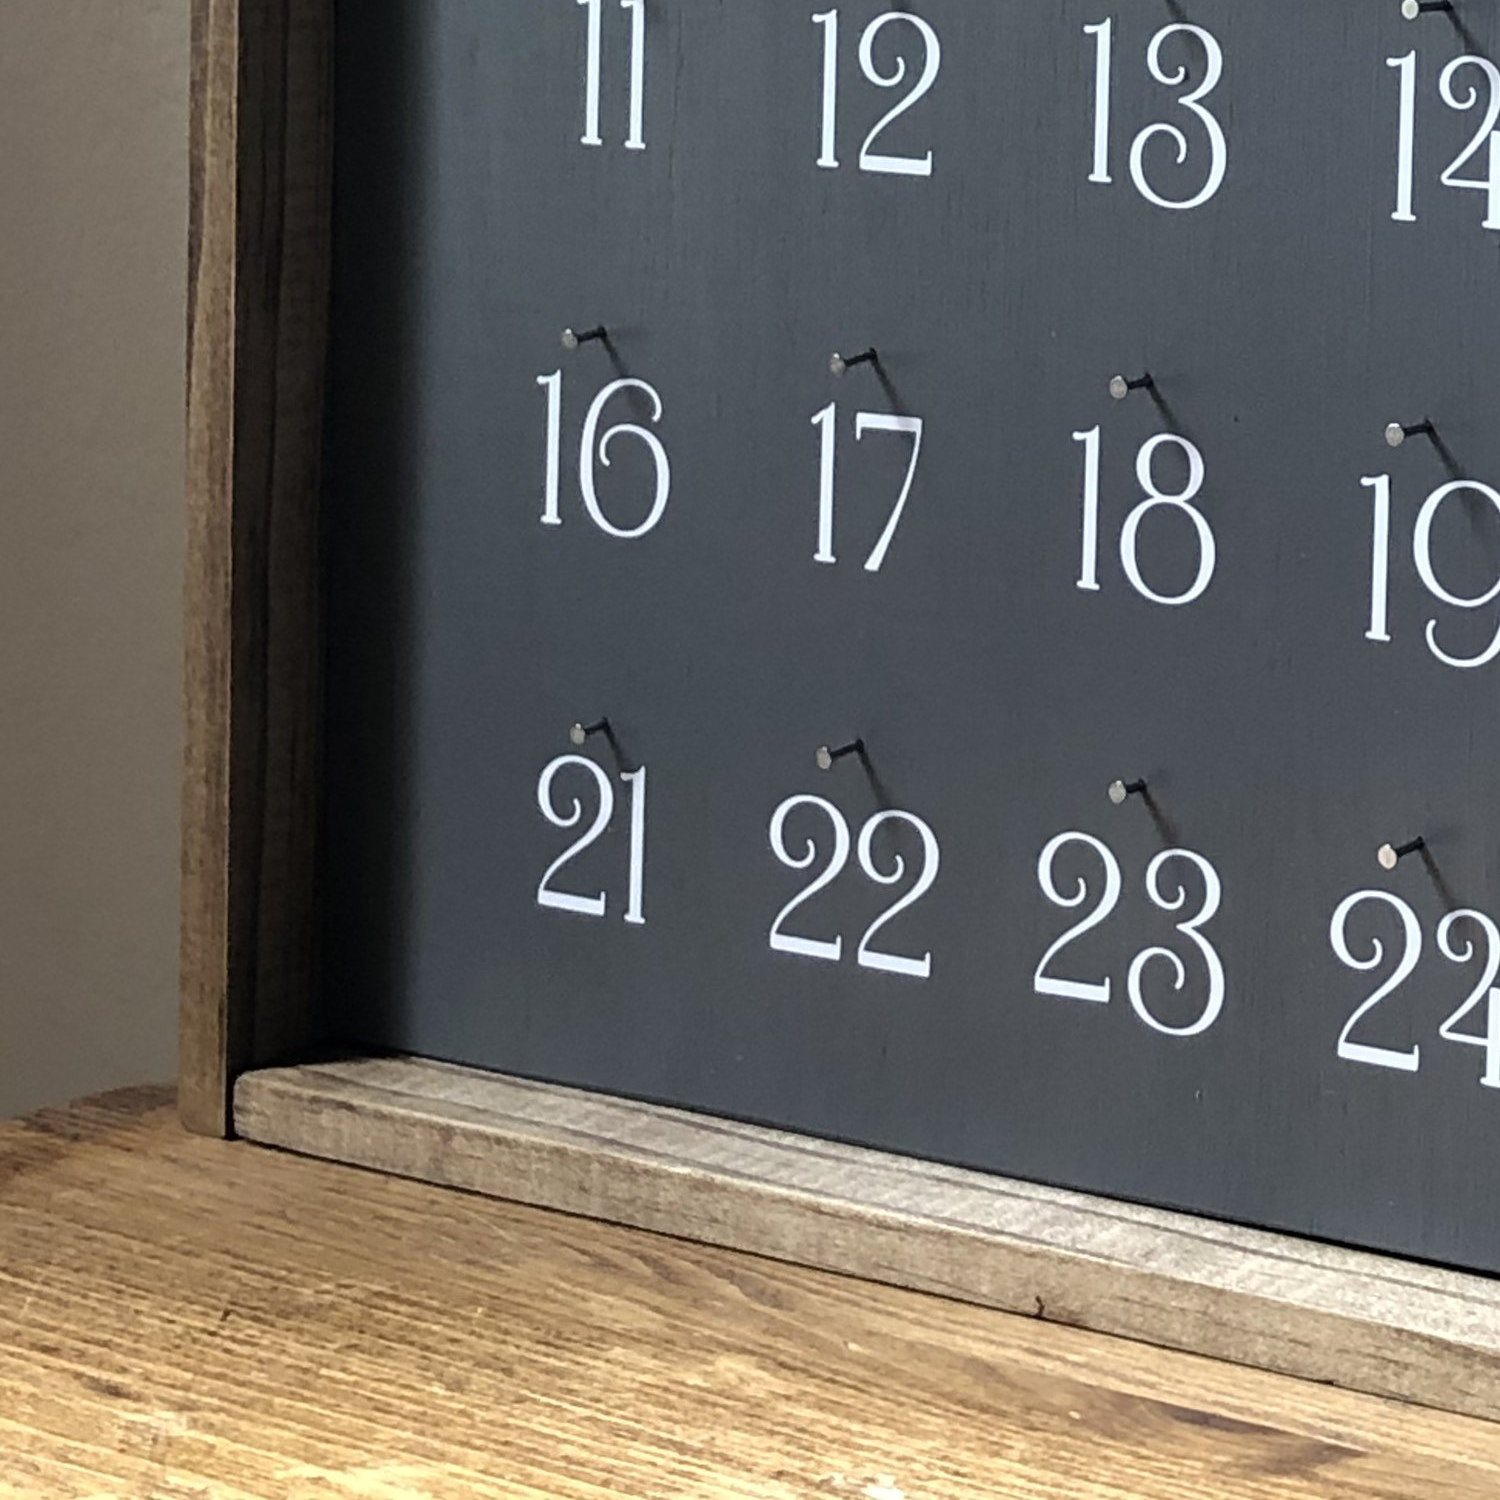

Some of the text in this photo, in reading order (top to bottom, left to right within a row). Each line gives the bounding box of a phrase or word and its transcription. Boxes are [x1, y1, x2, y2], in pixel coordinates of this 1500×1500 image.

[811, 8, 941, 177] 12
[1082, 16, 1227, 210] 13
[535, 368, 671, 539] 16
[810, 401, 923, 572] 17
[1071, 424, 1216, 605] 18
[536, 754, 646, 925] 21
[768, 794, 940, 979] 22
[1033, 831, 1225, 1037] 23
